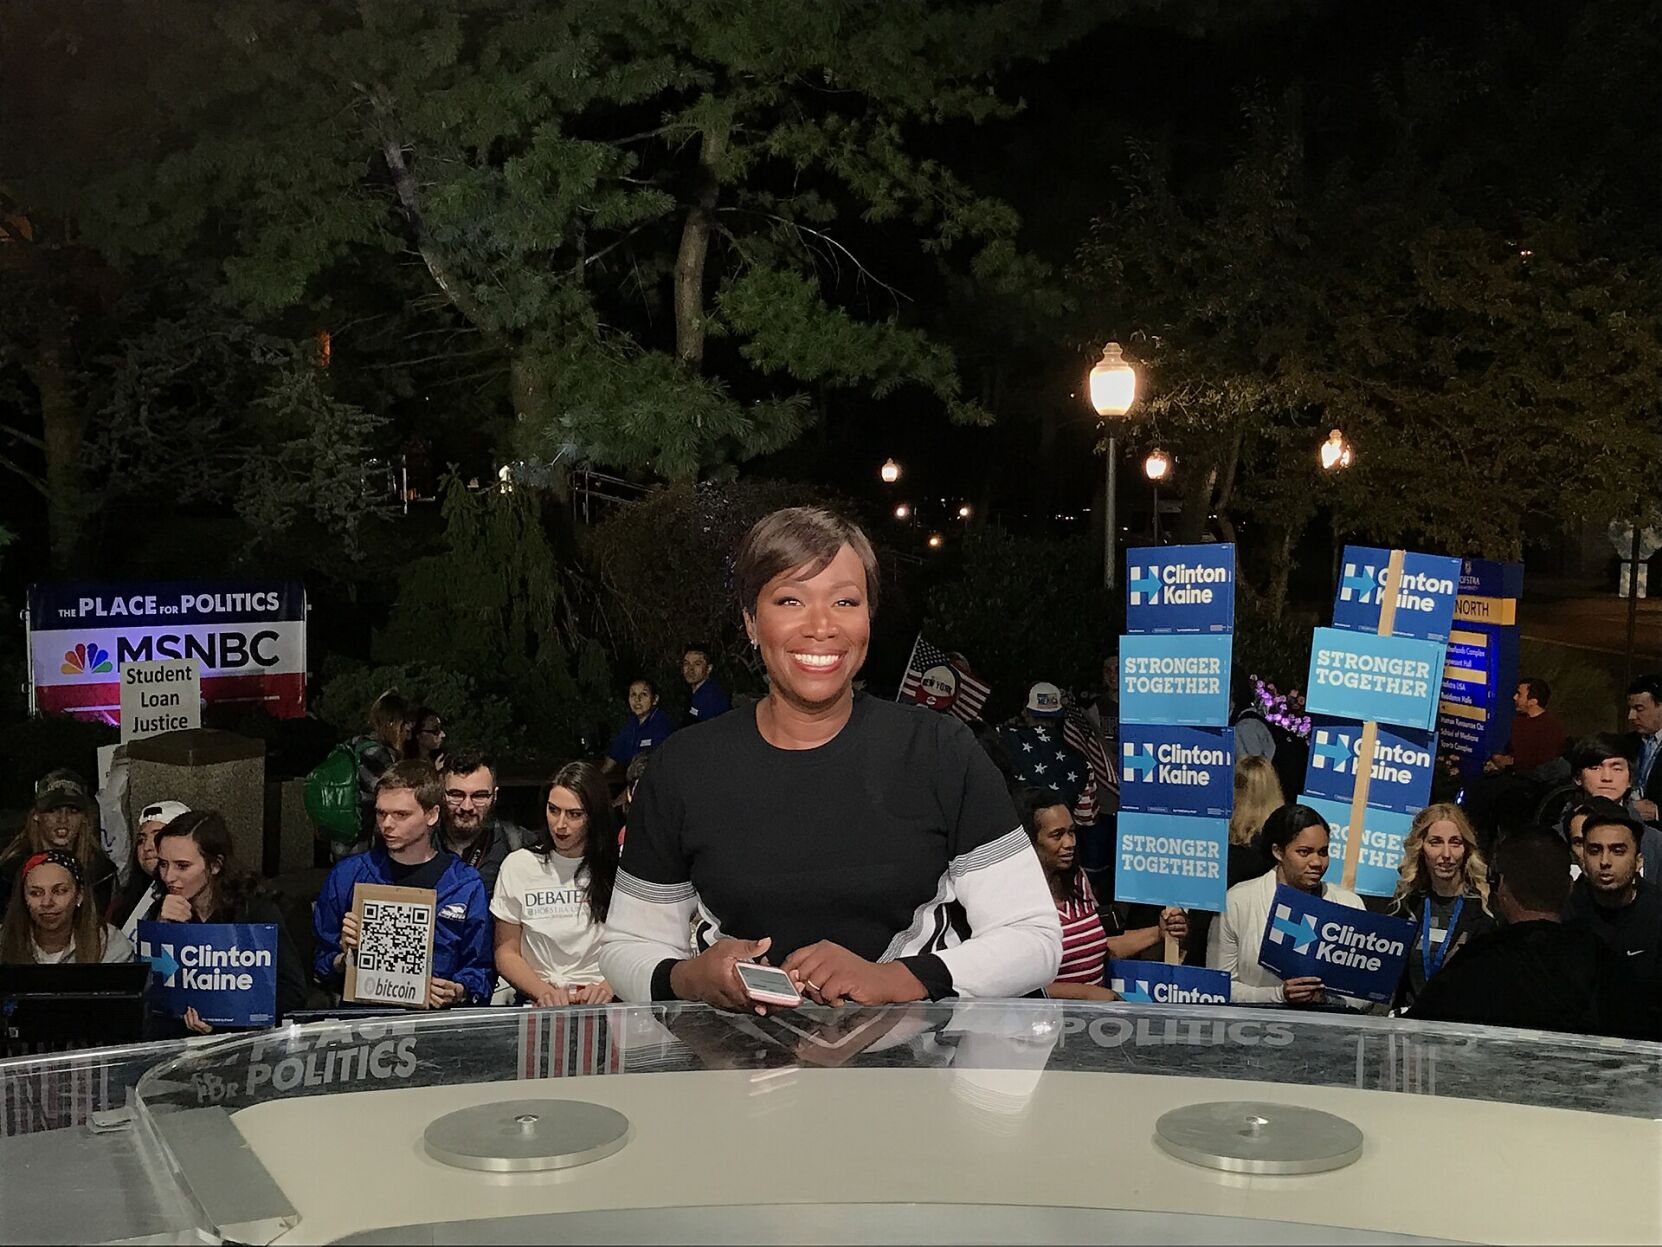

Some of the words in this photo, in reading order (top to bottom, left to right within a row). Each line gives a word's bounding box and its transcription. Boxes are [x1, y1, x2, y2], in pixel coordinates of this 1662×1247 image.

[1162, 564, 1226, 584] Clinton
[1378, 567, 1454, 595] Cinton
[58, 608, 77, 618] THE
[79, 596, 157, 617] PLACE
[159, 605, 178, 614] FOR
[181, 592, 280, 613] POLITICS
[1163, 584, 1213, 604] Kaine
[1455, 600, 1489, 616] NORTH
[116, 630, 281, 671] MSNBC
[126, 665, 192, 685] Student
[1124, 657, 1221, 674] STRONGER
[1317, 649, 1430, 679] STRONGER
[1124, 676, 1220, 694] TOGETHER
[1315, 667, 1428, 698] TOGETHER
[140, 691, 180, 708] Loan
[132, 715, 188, 734] Justice
[1157, 743, 1224, 766] Clinton
[1353, 737, 1431, 768] Cinton
[1158, 765, 1210, 786] Kaine
[1122, 834, 1220, 859] STRONGER
[1121, 854, 1220, 879] TOGETHER
[525, 889, 582, 907] DEBATE
[1321, 922, 1405, 956] Clinton
[180, 945, 271, 968] Clinton
[1315, 941, 1382, 972] Kaine
[182, 967, 253, 991] Kaine
[375, 978, 416, 1000] bitcoin
[1058, 1016, 1295, 1049] POLITICS
[246, 1037, 418, 1096] POLITICS
